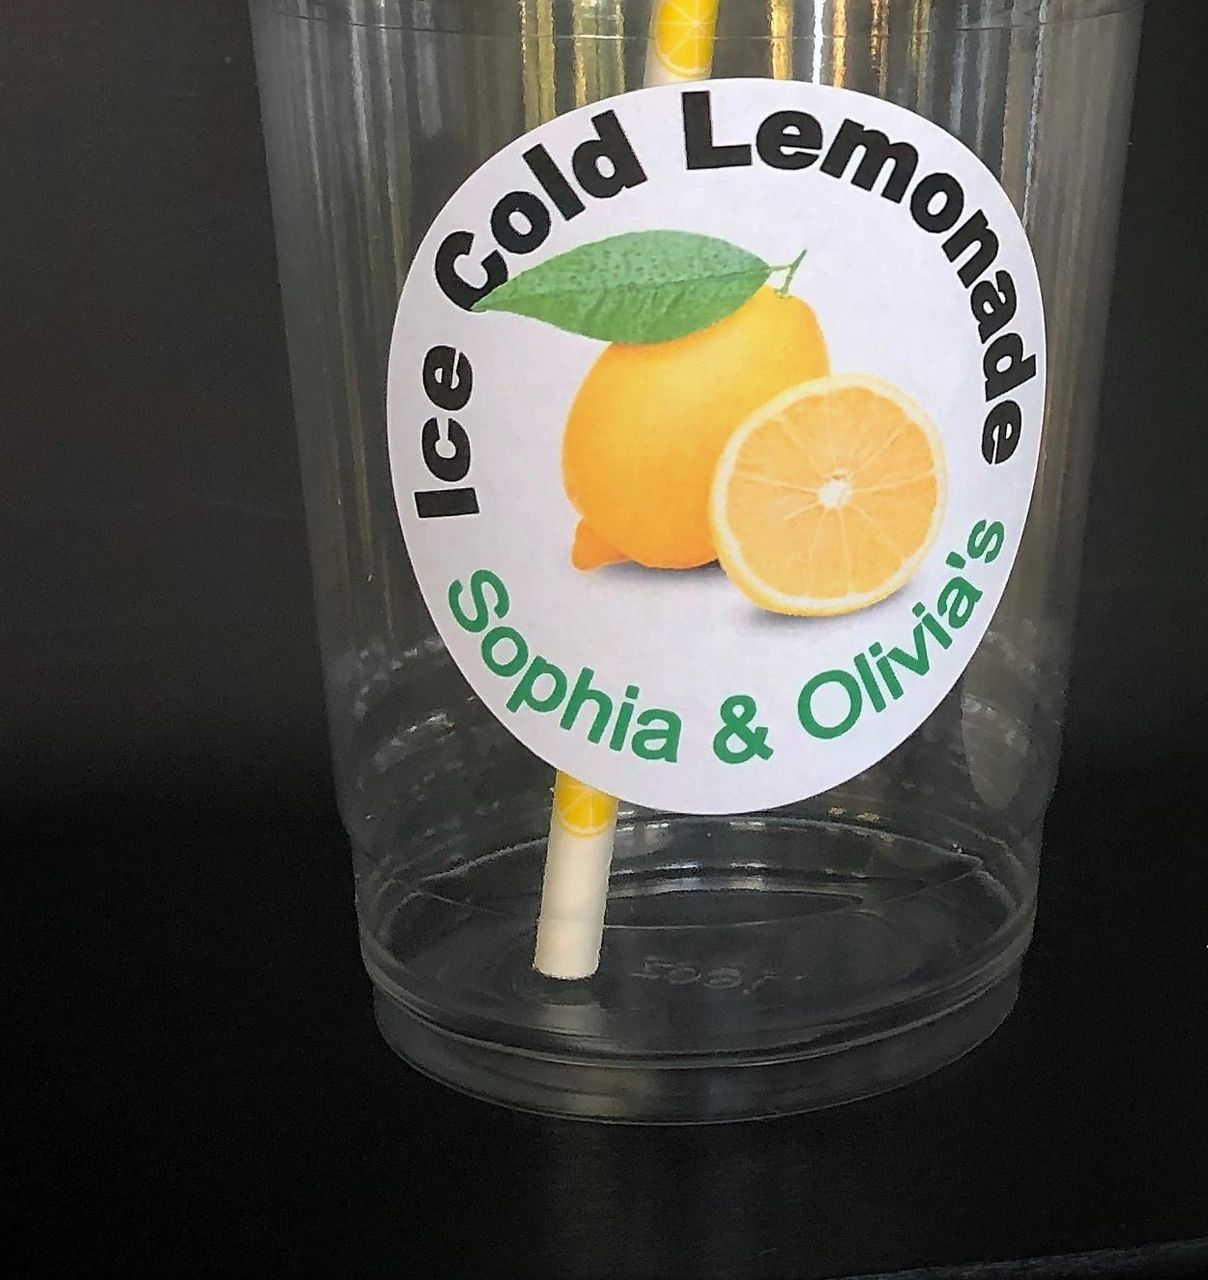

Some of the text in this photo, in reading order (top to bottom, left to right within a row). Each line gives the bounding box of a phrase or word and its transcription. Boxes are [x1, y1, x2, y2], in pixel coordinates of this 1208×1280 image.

[414, 90, 1038, 519] Ice Cold Lemonade
[448, 518, 1005, 765] Sophia & Olivia's
